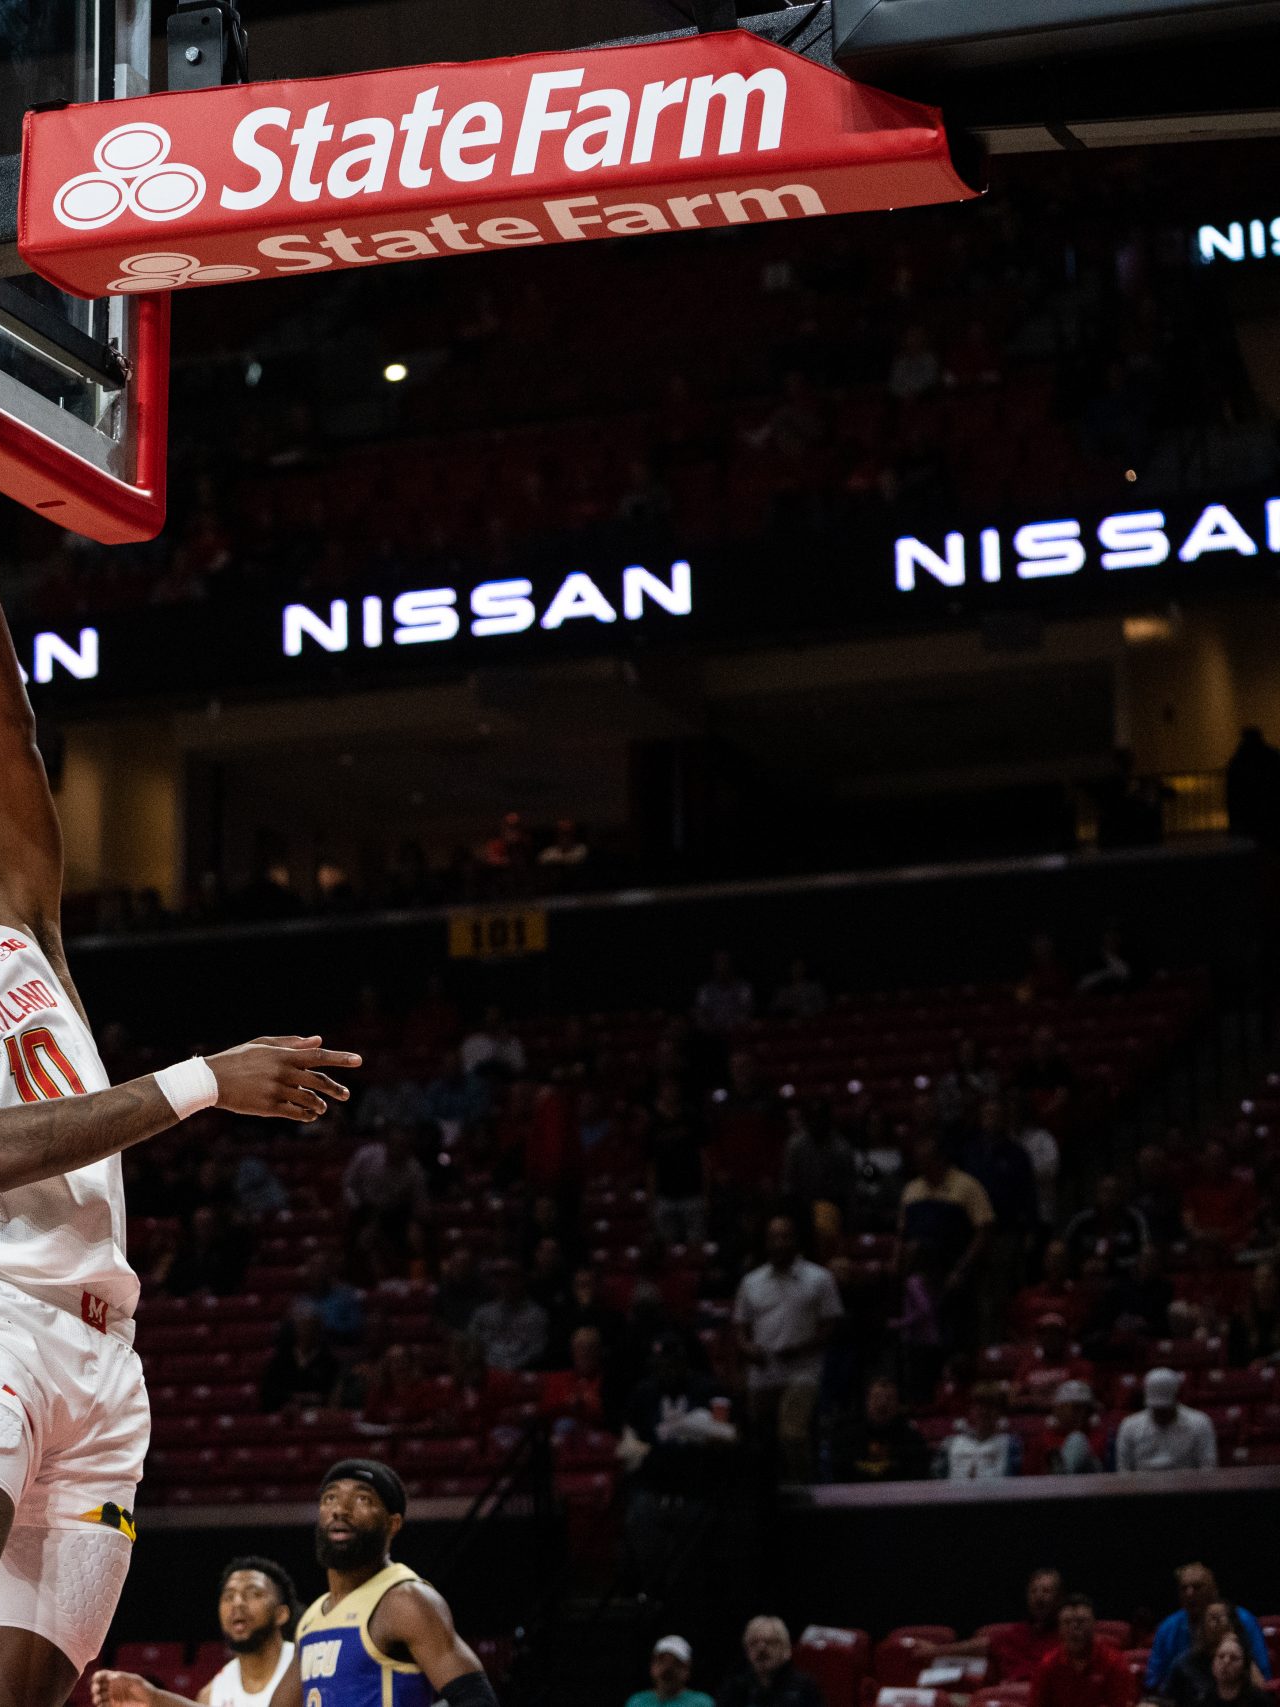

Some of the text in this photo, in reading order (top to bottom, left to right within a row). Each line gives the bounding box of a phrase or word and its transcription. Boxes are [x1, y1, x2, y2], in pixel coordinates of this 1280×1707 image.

[1198, 217, 1280, 262] NI
[896, 498, 1280, 592] NISSA
[285, 560, 693, 657] NISSAN
[3, 1027, 87, 1103] 10
